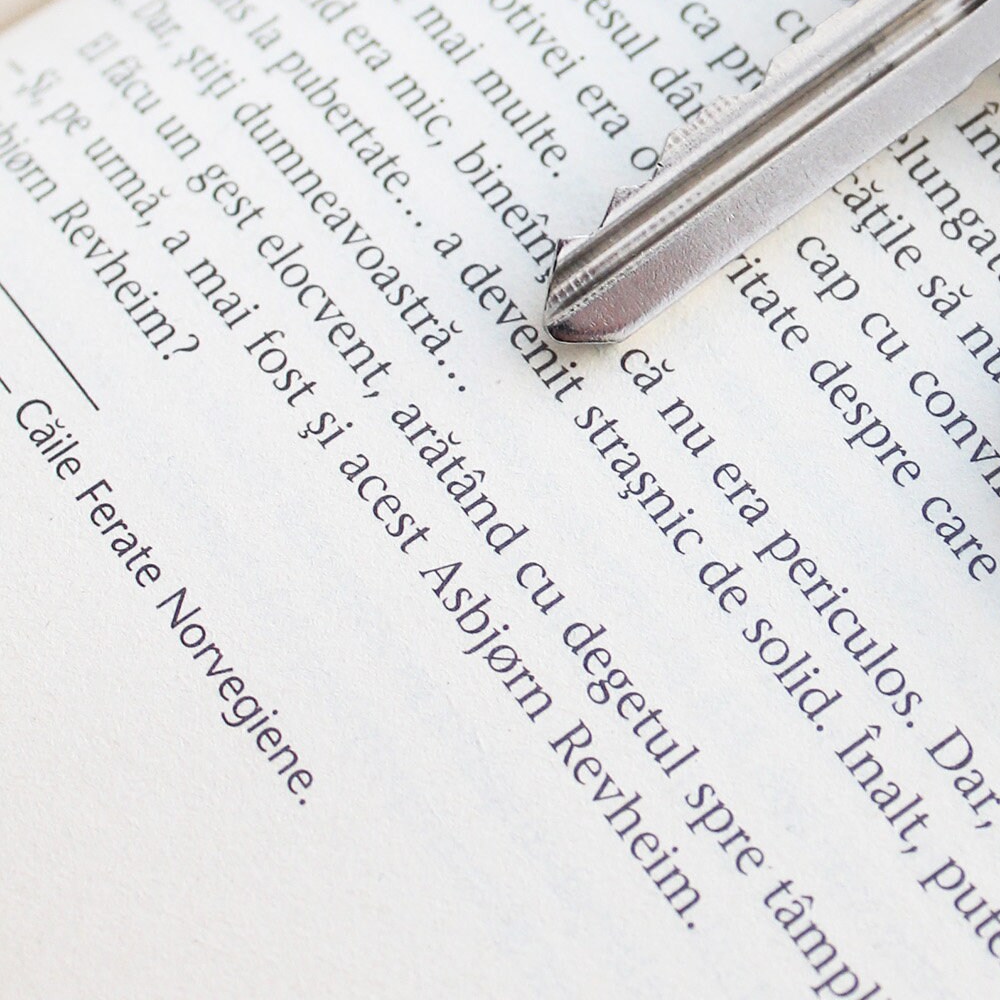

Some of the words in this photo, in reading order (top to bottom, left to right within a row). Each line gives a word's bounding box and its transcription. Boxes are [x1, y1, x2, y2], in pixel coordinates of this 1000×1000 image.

[0, 121, 58, 203] bjørn
[50, 198, 201, 362] Revheim?
[171, 45, 247, 101] ştiţi
[412, 3, 485, 67] mai
[471, 68, 568, 179] multe.
[678, 1, 721, 42] ca
[916, 274, 973, 321] să
[76, 30, 120, 65] El
[100, 56, 162, 116] făcu
[154, 114, 202, 162] un
[185, 163, 265, 231] gest
[256, 234, 393, 400] elocvent,
[390, 402, 531, 556] arătând
[515, 561, 566, 617] cu
[561, 621, 701, 779] degetul
[683, 782, 766, 877] spre
[246, 14, 283, 52] la
[432, 231, 464, 261] a
[459, 262, 585, 404] devenit
[572, 404, 705, 556] straşnic
[698, 560, 749, 615] de
[741, 617, 844, 733] solid.
[833, 723, 930, 855] Înalt,
[341, 25, 393, 73] era
[385, 73, 453, 148] mic,
[619, 348, 676, 396] că
[656, 395, 716, 459] nu
[711, 462, 771, 529] era
[751, 528, 924, 729] periculos.
[575, 83, 631, 140] era
[808, 359, 922, 489] despre
[920, 495, 998, 583] care
[795, 235, 861, 303] cap
[859, 311, 911, 364] cu
[15, 398, 82, 481] Căile
[74, 478, 162, 589] Ferate
[155, 586, 315, 807] Norvegiene.
[37, 100, 92, 136] pe
[83, 135, 169, 228] urmă,
[161, 229, 192, 257] a
[183, 257, 261, 331] mai
[243, 328, 318, 408] fost
[296, 410, 354, 451] şi
[338, 452, 432, 555] acest
[417, 560, 554, 724] Asbjørn
[547, 718, 702, 931] Revheim.
